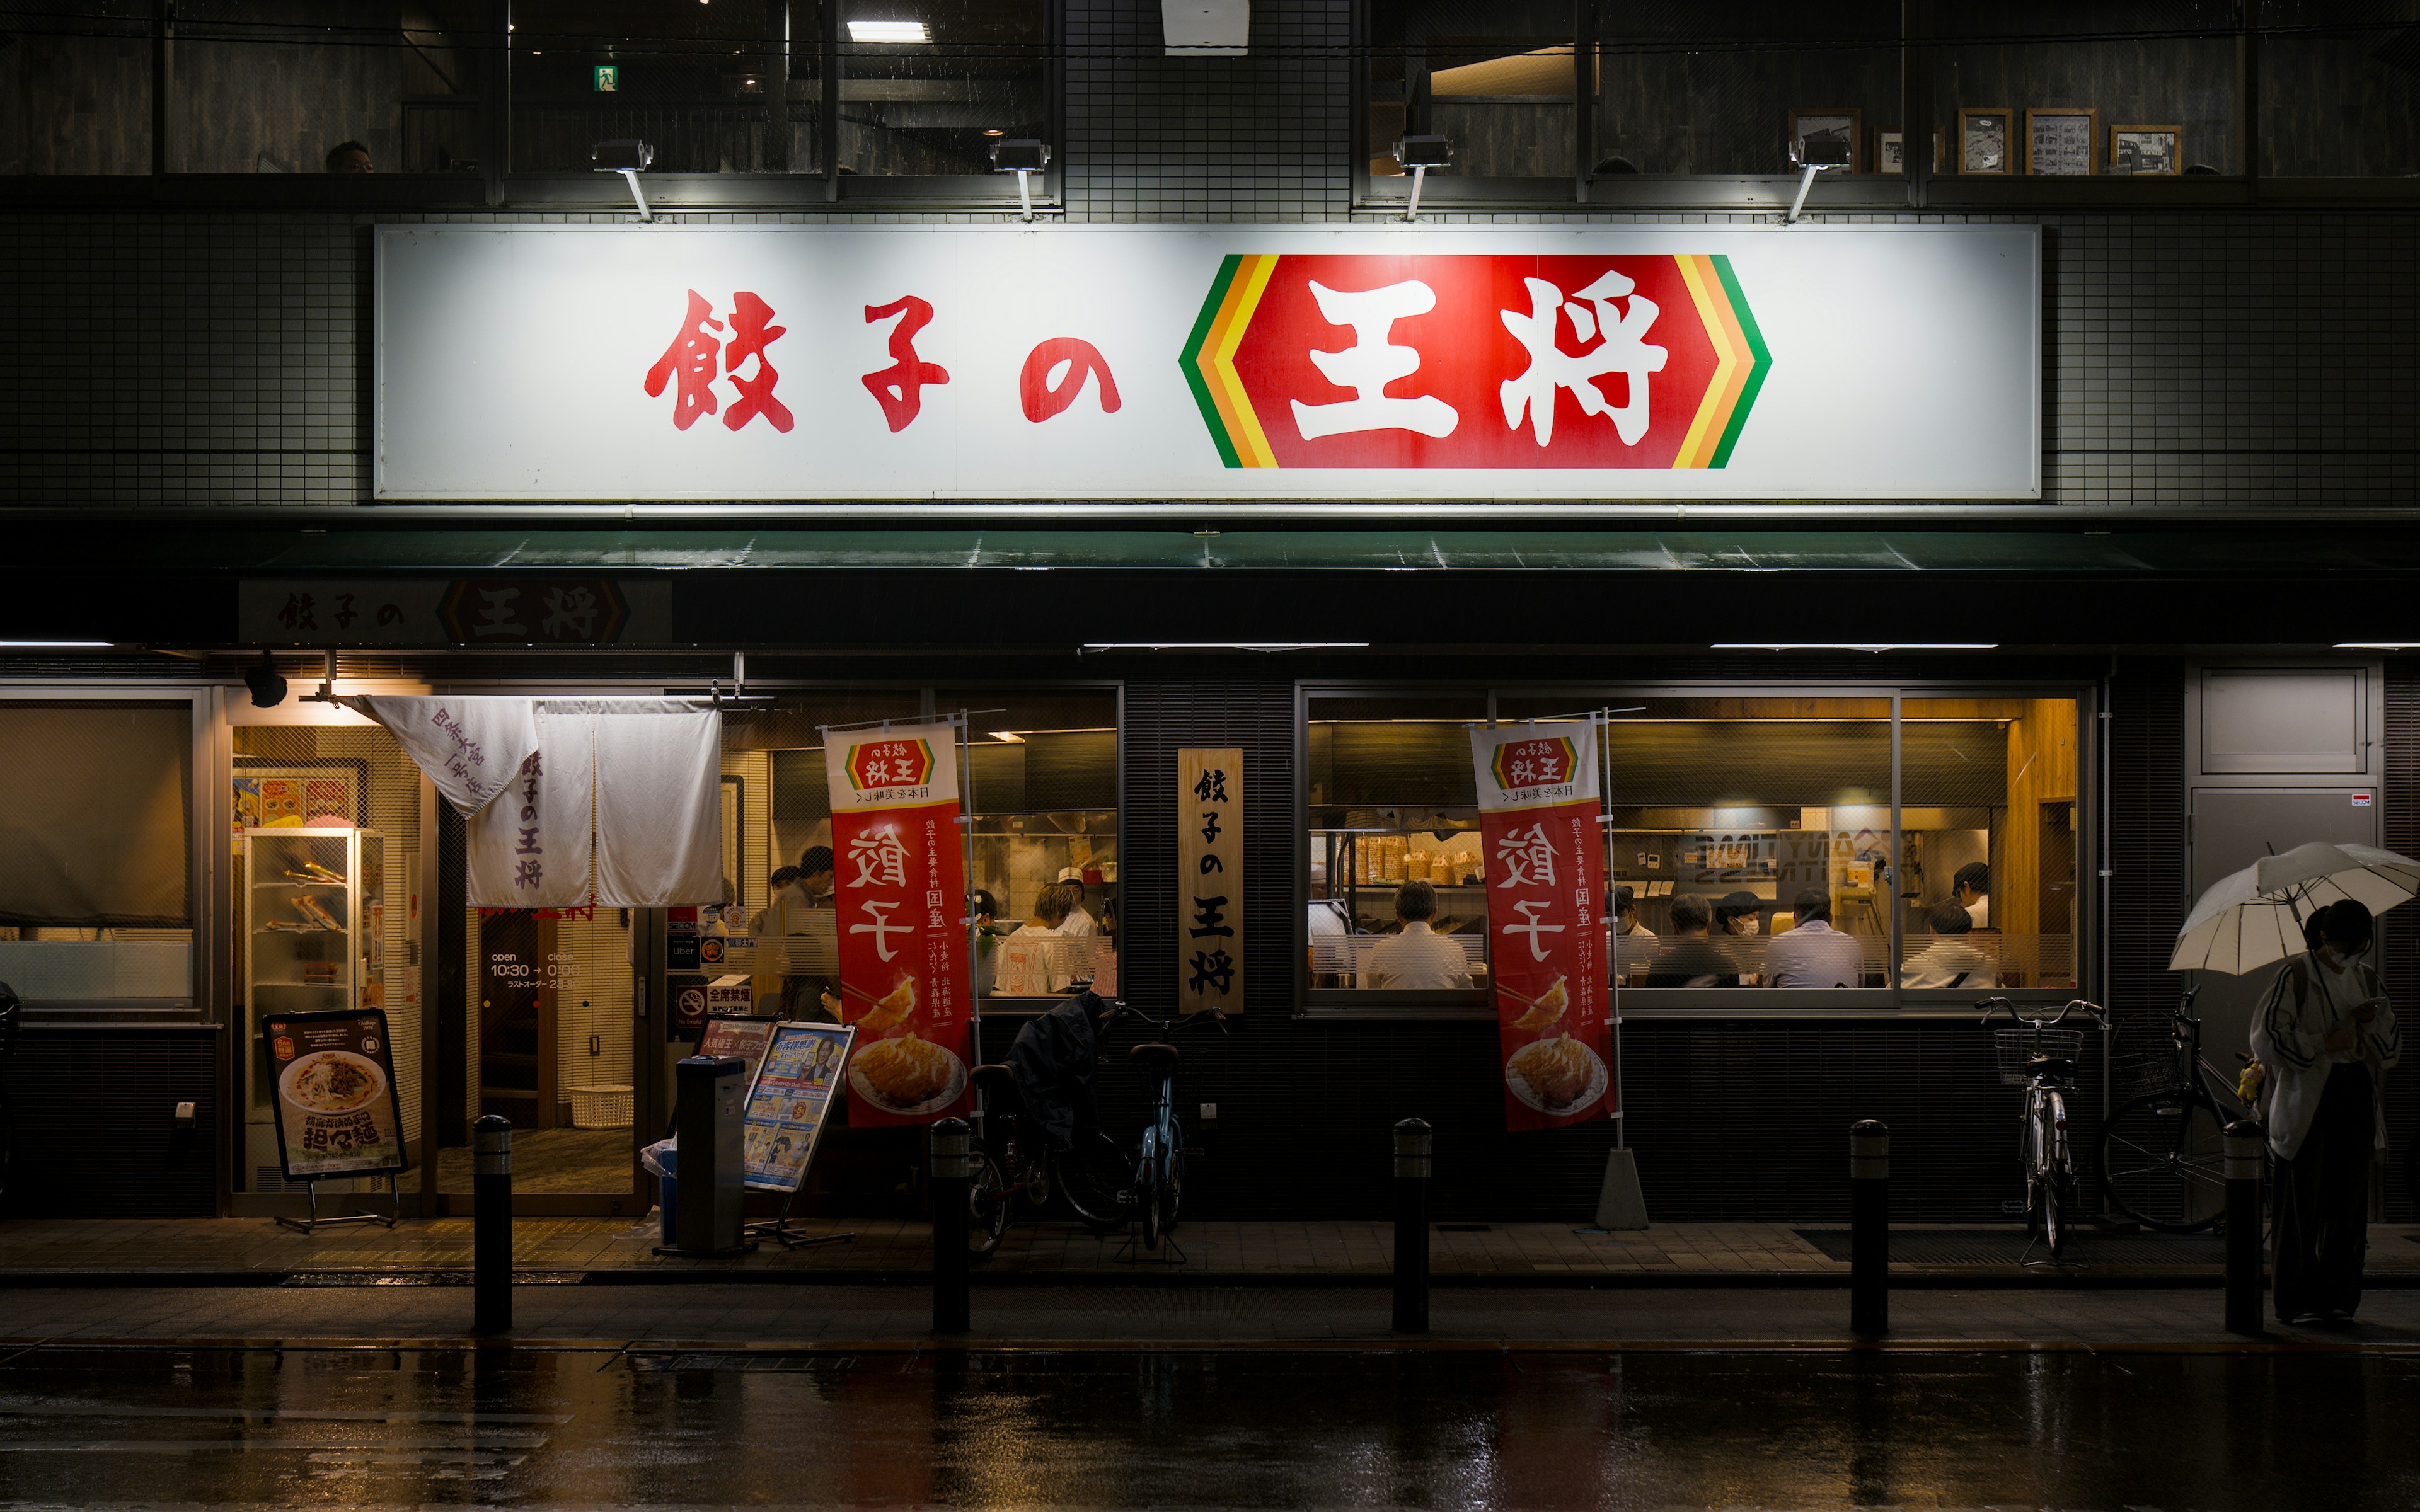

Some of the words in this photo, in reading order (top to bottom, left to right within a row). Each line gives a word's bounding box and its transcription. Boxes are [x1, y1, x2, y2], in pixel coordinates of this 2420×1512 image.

[644, 270, 1669, 448] 餃子の王将
[277, 585, 599, 639] 餃子の王将
[431, 707, 485, 767] 四条大宮
[444, 755, 484, 797] 一号店
[1189, 768, 1235, 996] 餃子の王将
[490, 964, 529, 976] 10:30
[492, 953, 516, 962] open
[548, 952, 573, 961] close
[673, 947, 694, 955] Uber
[710, 988, 751, 1002] 全席禁煙
